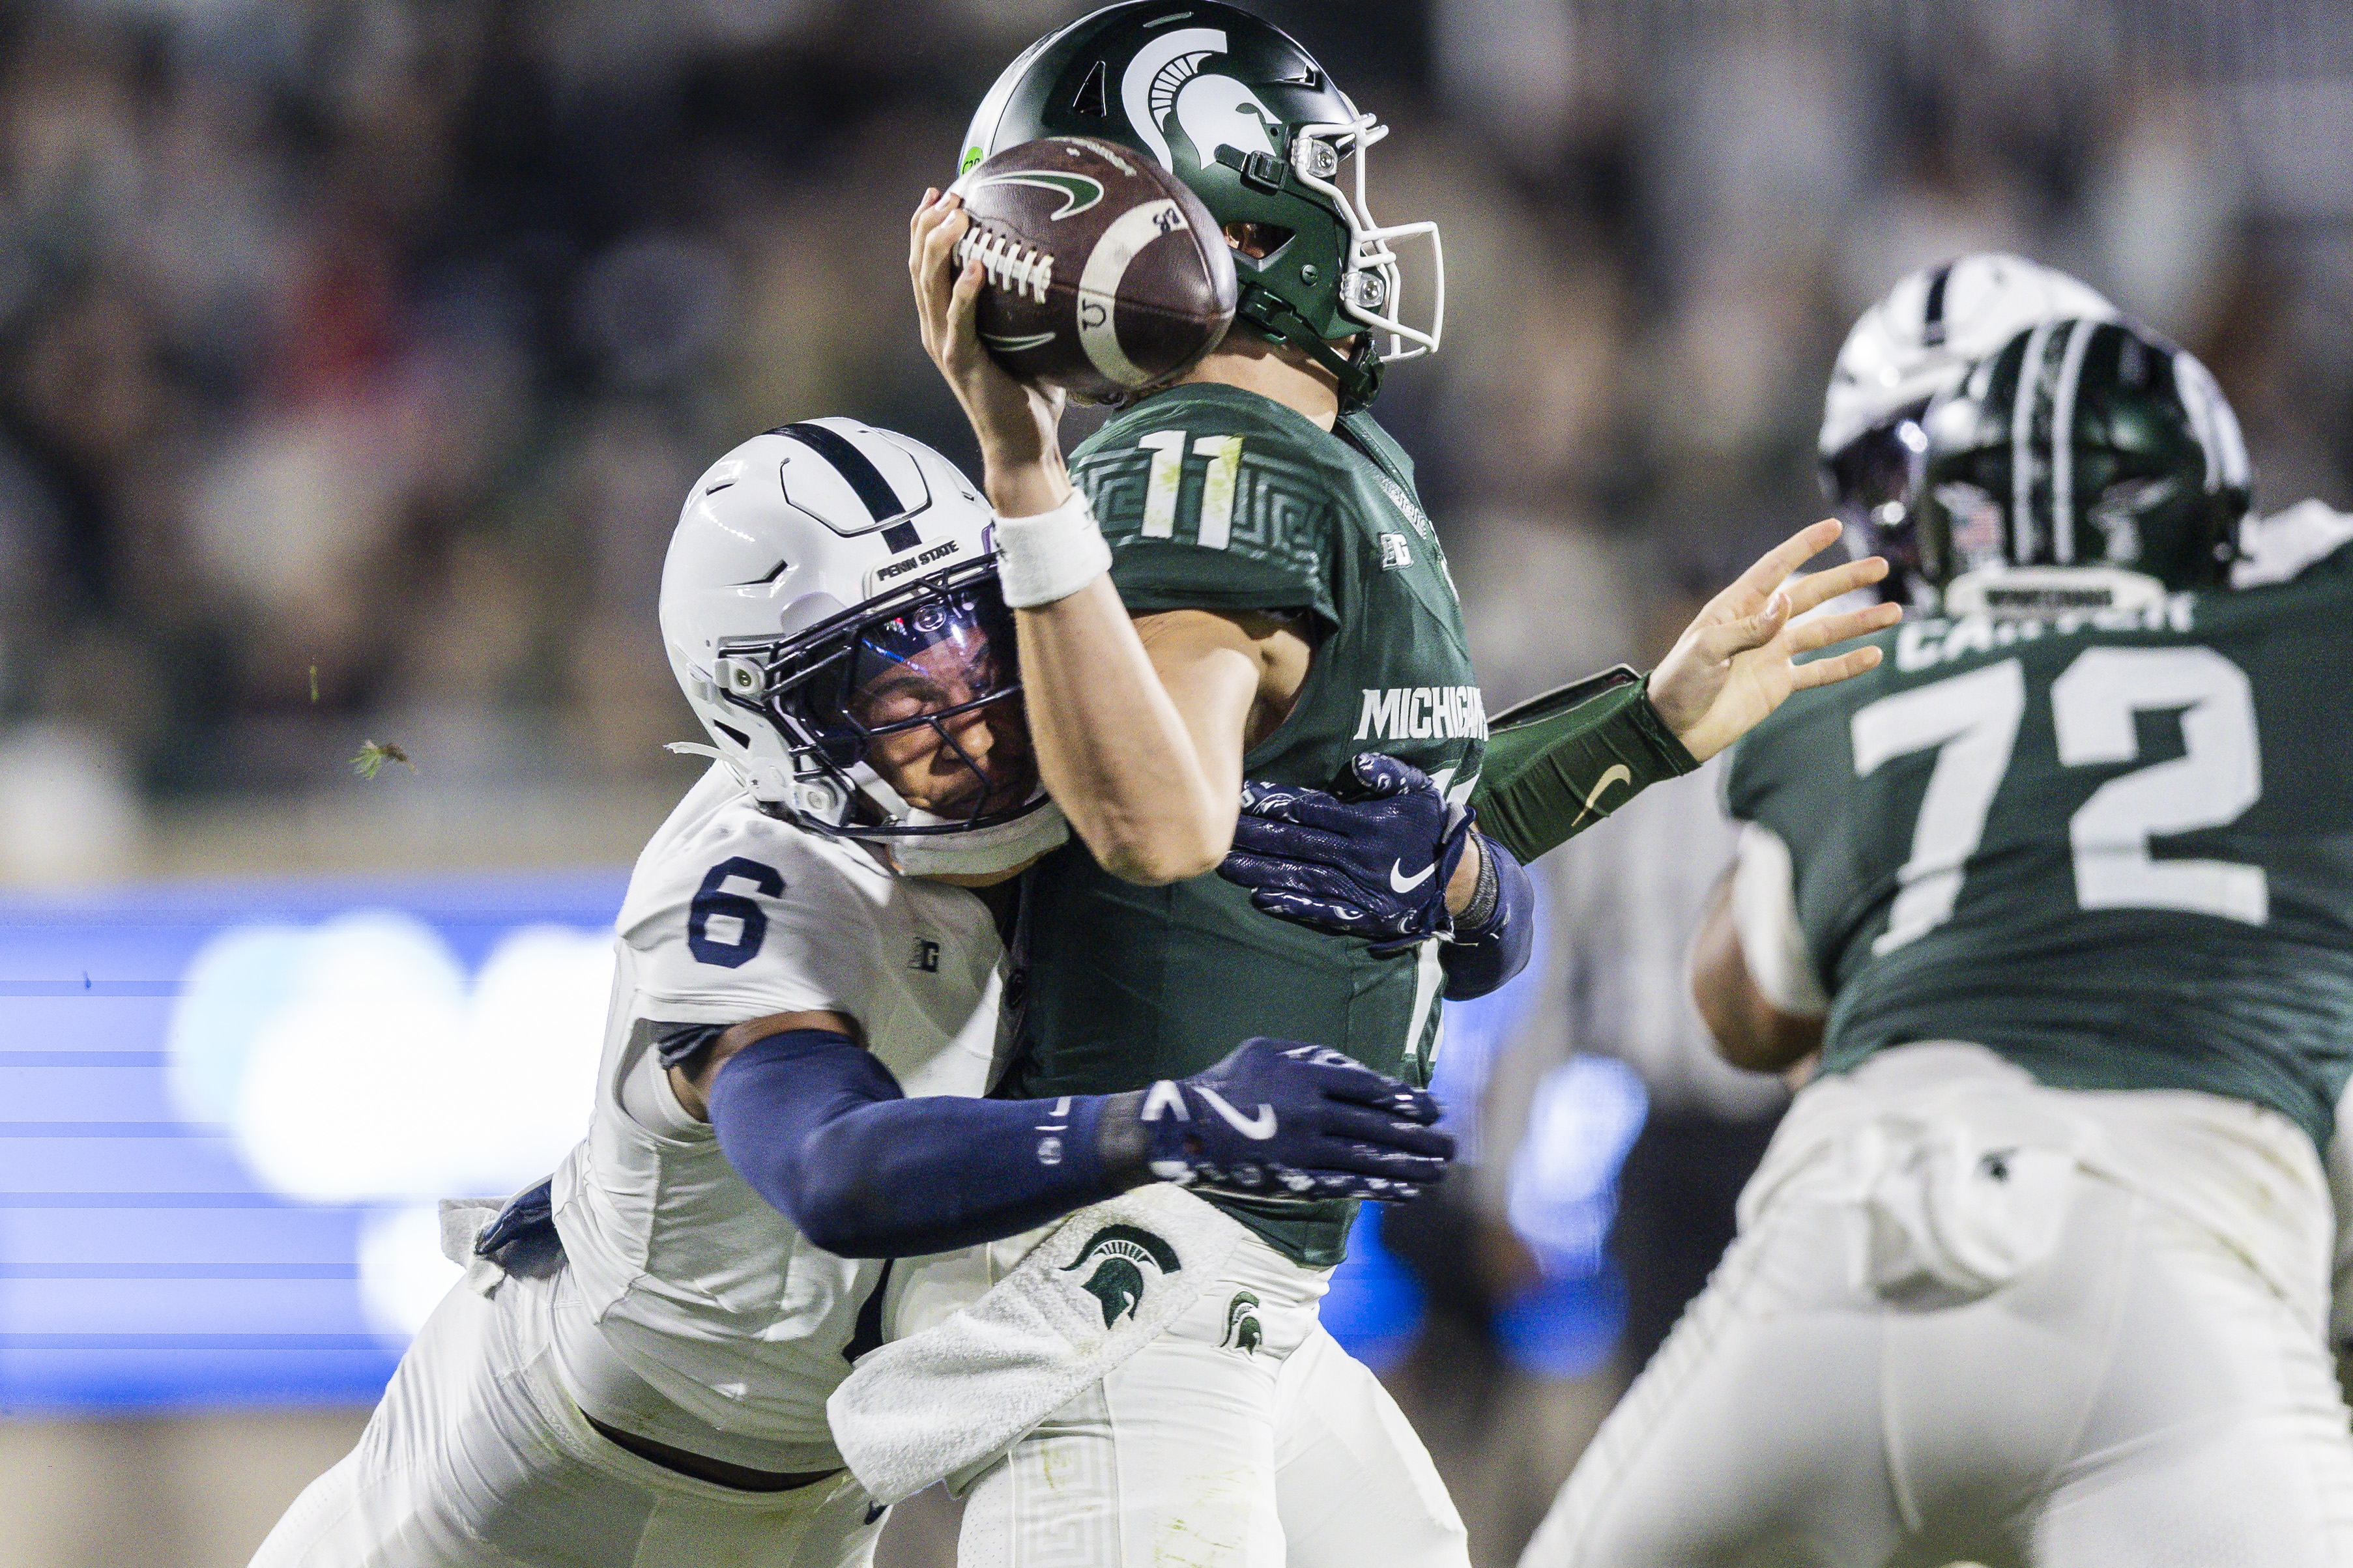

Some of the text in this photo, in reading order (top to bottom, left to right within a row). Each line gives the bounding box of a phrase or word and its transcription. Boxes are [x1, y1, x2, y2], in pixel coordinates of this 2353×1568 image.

[1138, 430, 1244, 550] 11
[876, 539, 960, 581] PENN STATE
[1851, 646, 2270, 958] 72
[688, 856, 786, 969] 6
